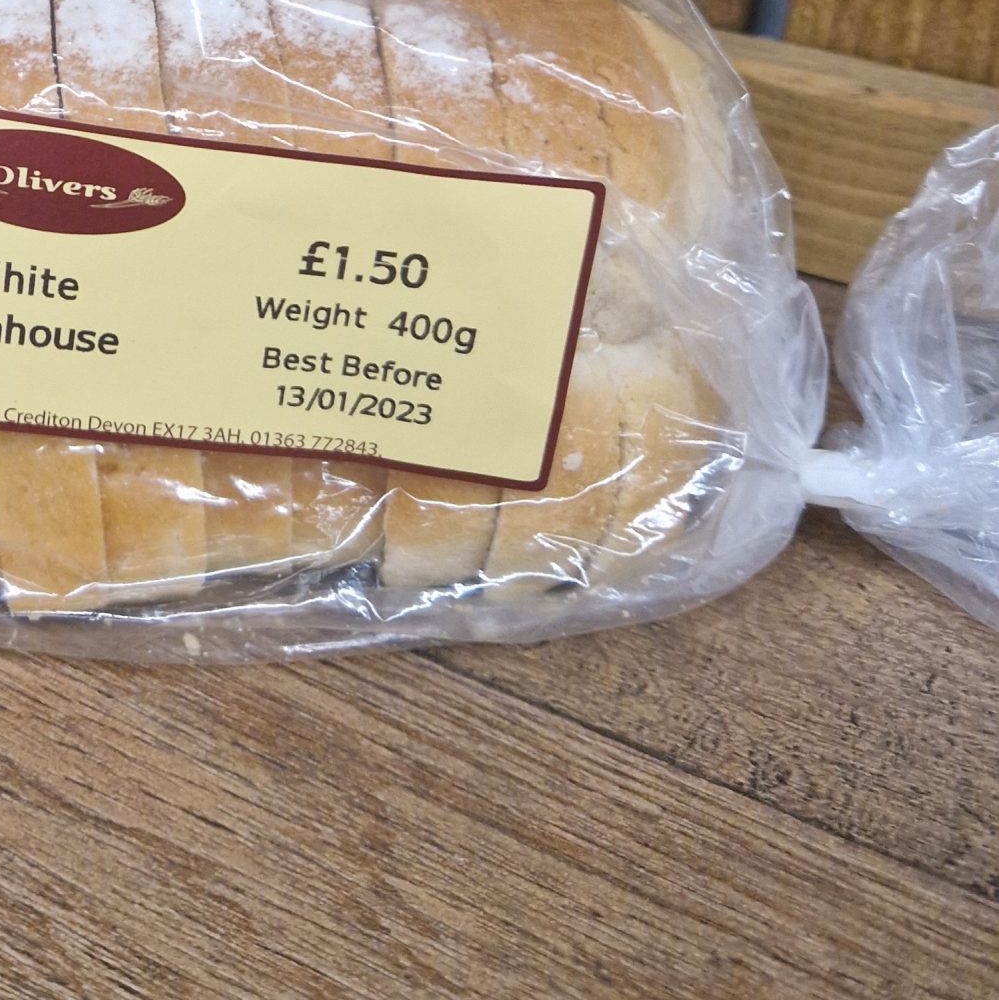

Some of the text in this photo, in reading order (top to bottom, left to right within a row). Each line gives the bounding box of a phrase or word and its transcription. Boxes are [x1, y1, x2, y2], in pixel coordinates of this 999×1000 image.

[298, 240, 430, 289] £1.50
[255, 295, 478, 355] Weight 400g
[261, 346, 443, 391] Best Before
[4, 406, 82, 430] Crediton
[88, 415, 147, 436] Devon
[152, 420, 199, 441] EX17
[250, 430, 306, 449] 01363
[276, 384, 433, 426] 13/01/2023
